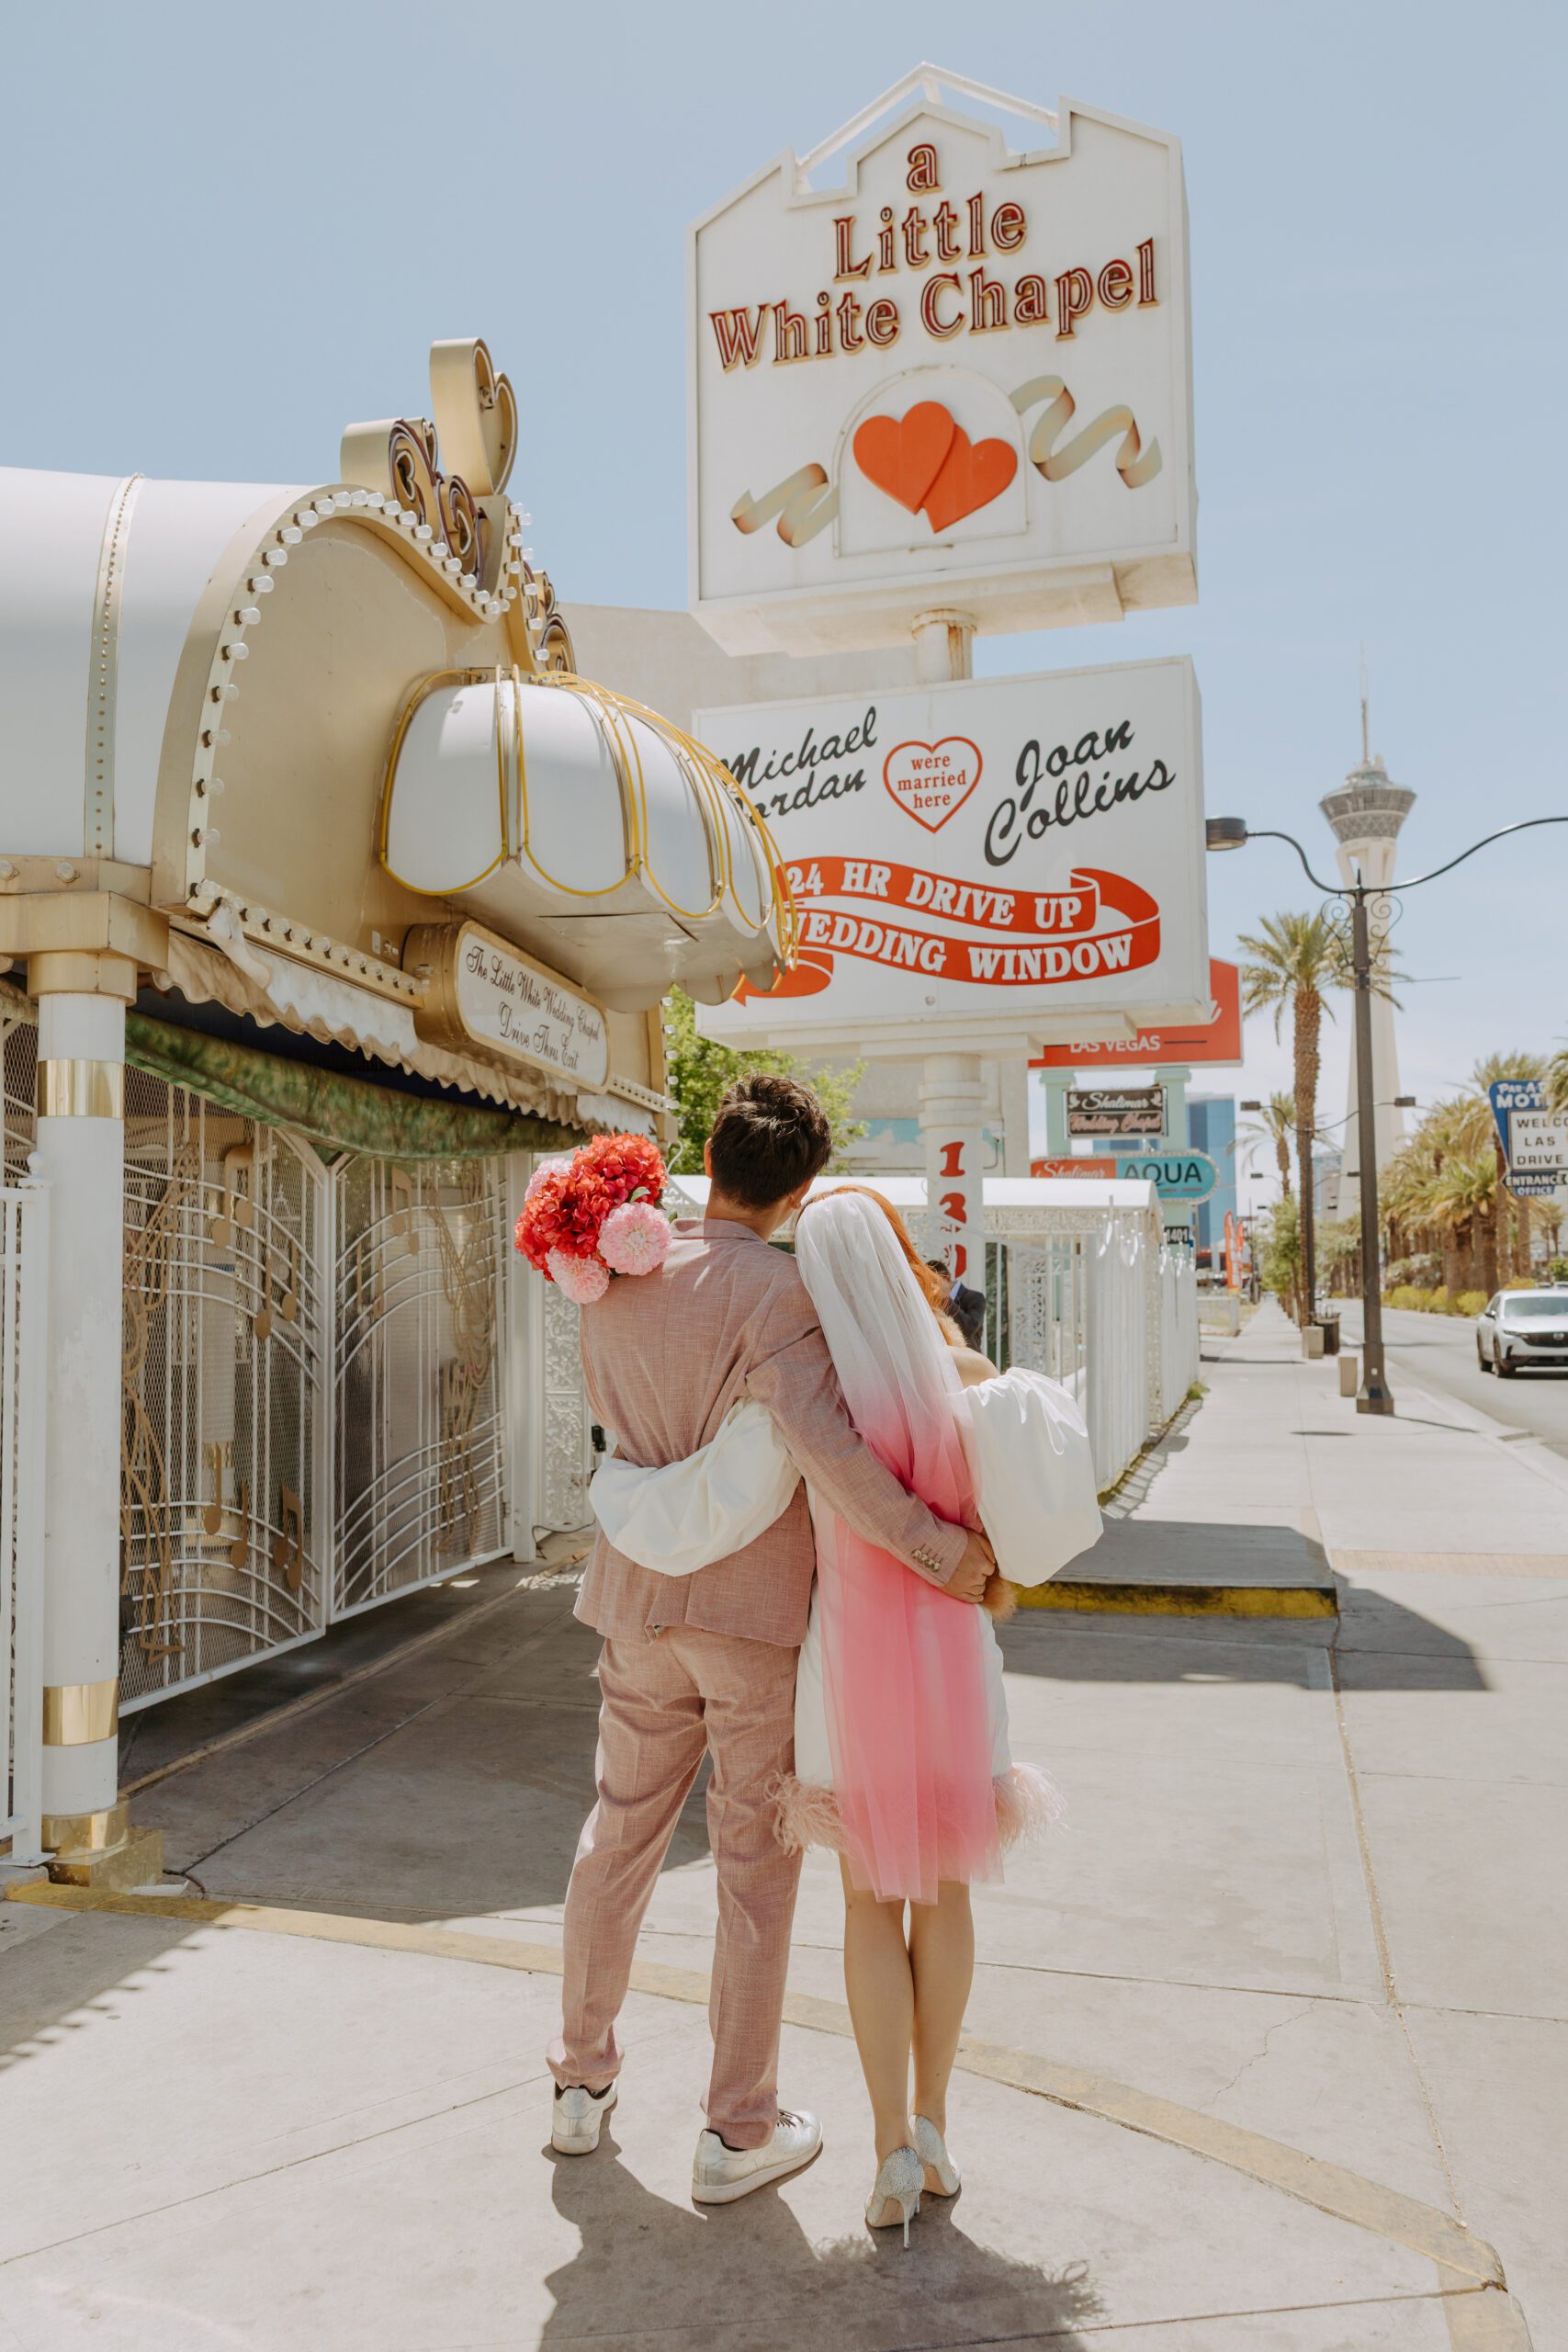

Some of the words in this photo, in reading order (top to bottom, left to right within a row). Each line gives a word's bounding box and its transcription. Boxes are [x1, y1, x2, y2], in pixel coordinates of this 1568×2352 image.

[907, 143, 941, 195] a
[833, 192, 1026, 283] Little
[709, 291, 899, 373] White
[921, 238, 1159, 343] Chapel
[721, 707, 877, 789] Michael
[910, 755, 951, 771] were
[1016, 719, 1135, 812] Joan
[735, 770, 866, 826] ordan
[897, 770, 967, 791] married
[913, 791, 952, 809] here
[985, 759, 1176, 866] Collins
[787, 863, 824, 896] 24
[840, 862, 891, 897] HR
[906, 873, 1014, 927] DRIVE
[1034, 897, 1083, 929] UP
[967, 933, 1133, 980] WINDOW
[467, 945, 488, 979] The
[490, 956, 515, 995] Little
[518, 971, 541, 1009] White
[544, 987, 575, 1035] Wedding
[577, 1005, 599, 1045] Chapel
[499, 1001, 529, 1048] Drive
[533, 1024, 558, 1062] Thru
[561, 1035, 579, 1071] Exit
[1070, 1042, 1100, 1053] LAS
[1105, 1035, 1161, 1052] VEGAS
[1081, 1091, 1149, 1111] Shalimar
[1496, 1093, 1552, 1109] MOT
[1525, 1136, 1556, 1147] LAS
[1124, 1162, 1202, 1186] AQUA
[1517, 1154, 1563, 1166] DRIVE
[1506, 1175, 1562, 1186] ENTRANCE
[1166, 1228, 1189, 1241] 1401
